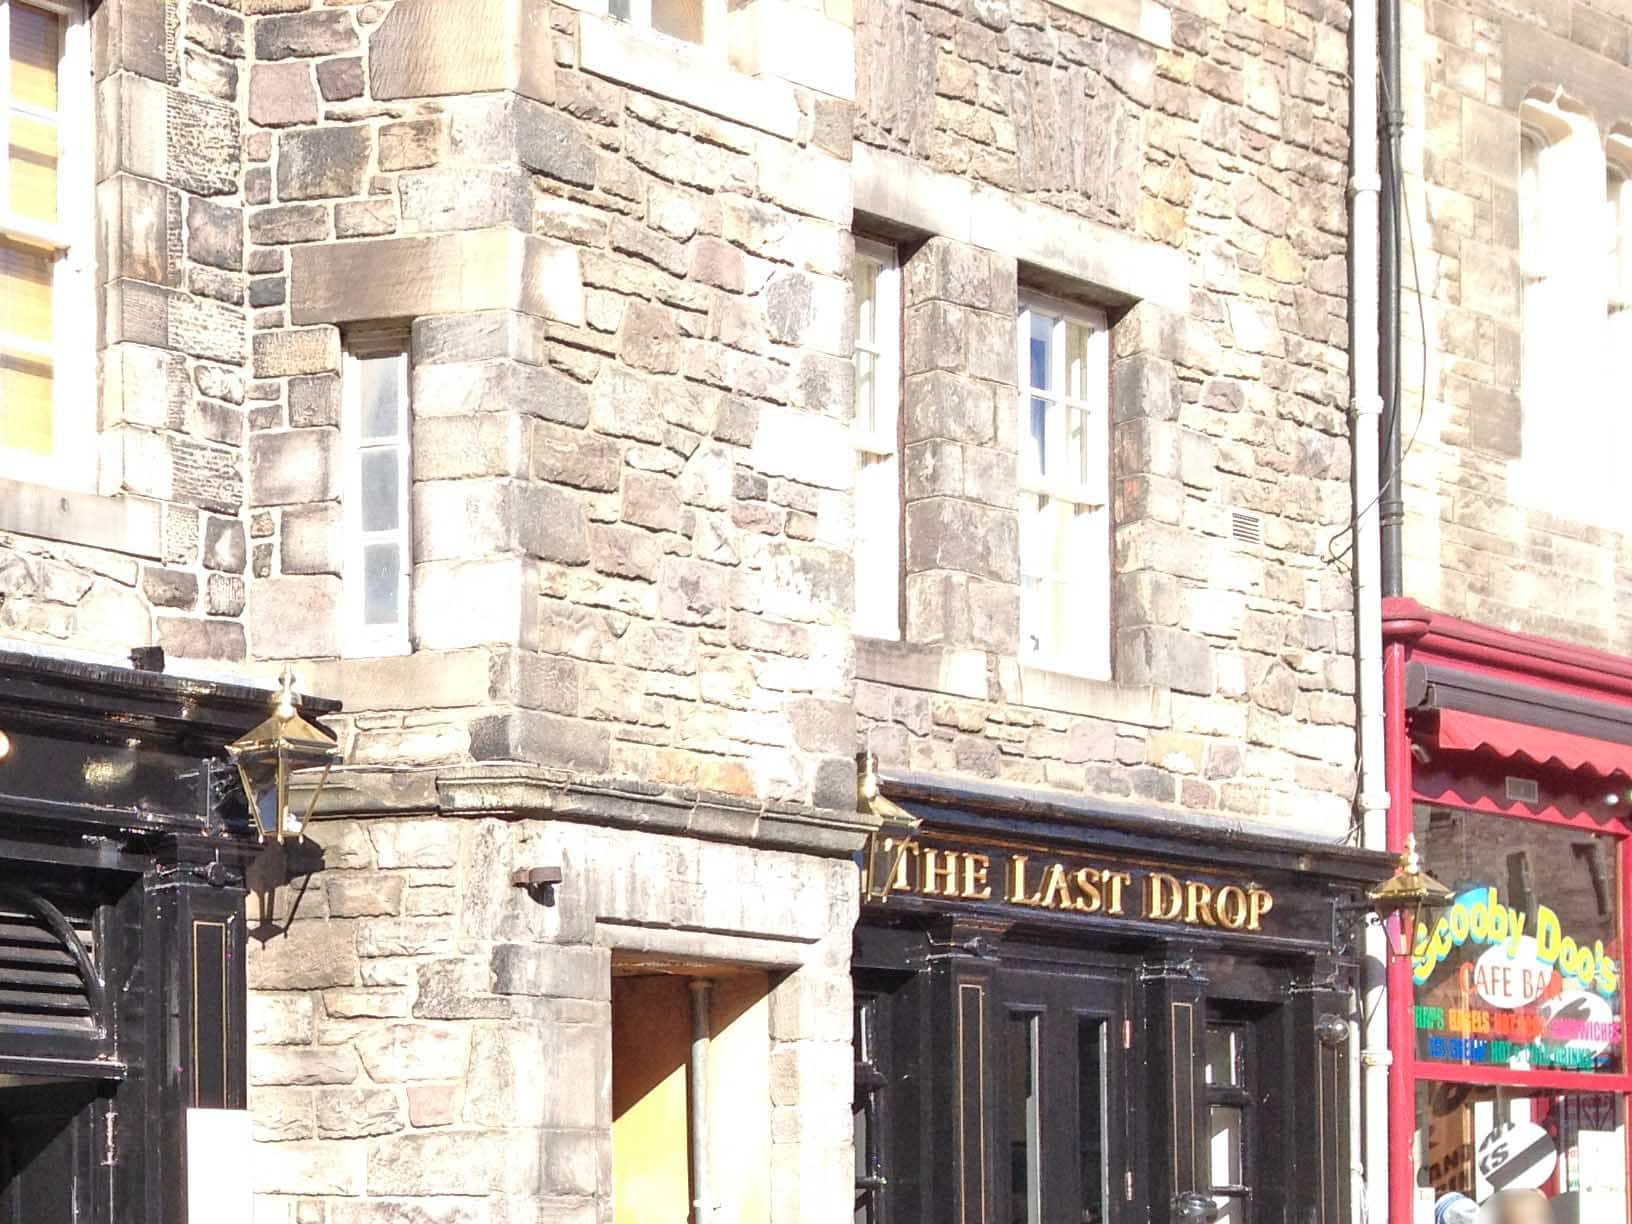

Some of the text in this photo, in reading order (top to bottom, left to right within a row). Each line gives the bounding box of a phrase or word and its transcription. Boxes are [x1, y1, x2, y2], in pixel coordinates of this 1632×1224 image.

[884, 838, 1274, 931] THE LAST DROP
[1459, 961, 1514, 998] CAFE
[1535, 903, 1618, 1000] Doo's
[1551, 1016, 1622, 1045] WICHES
